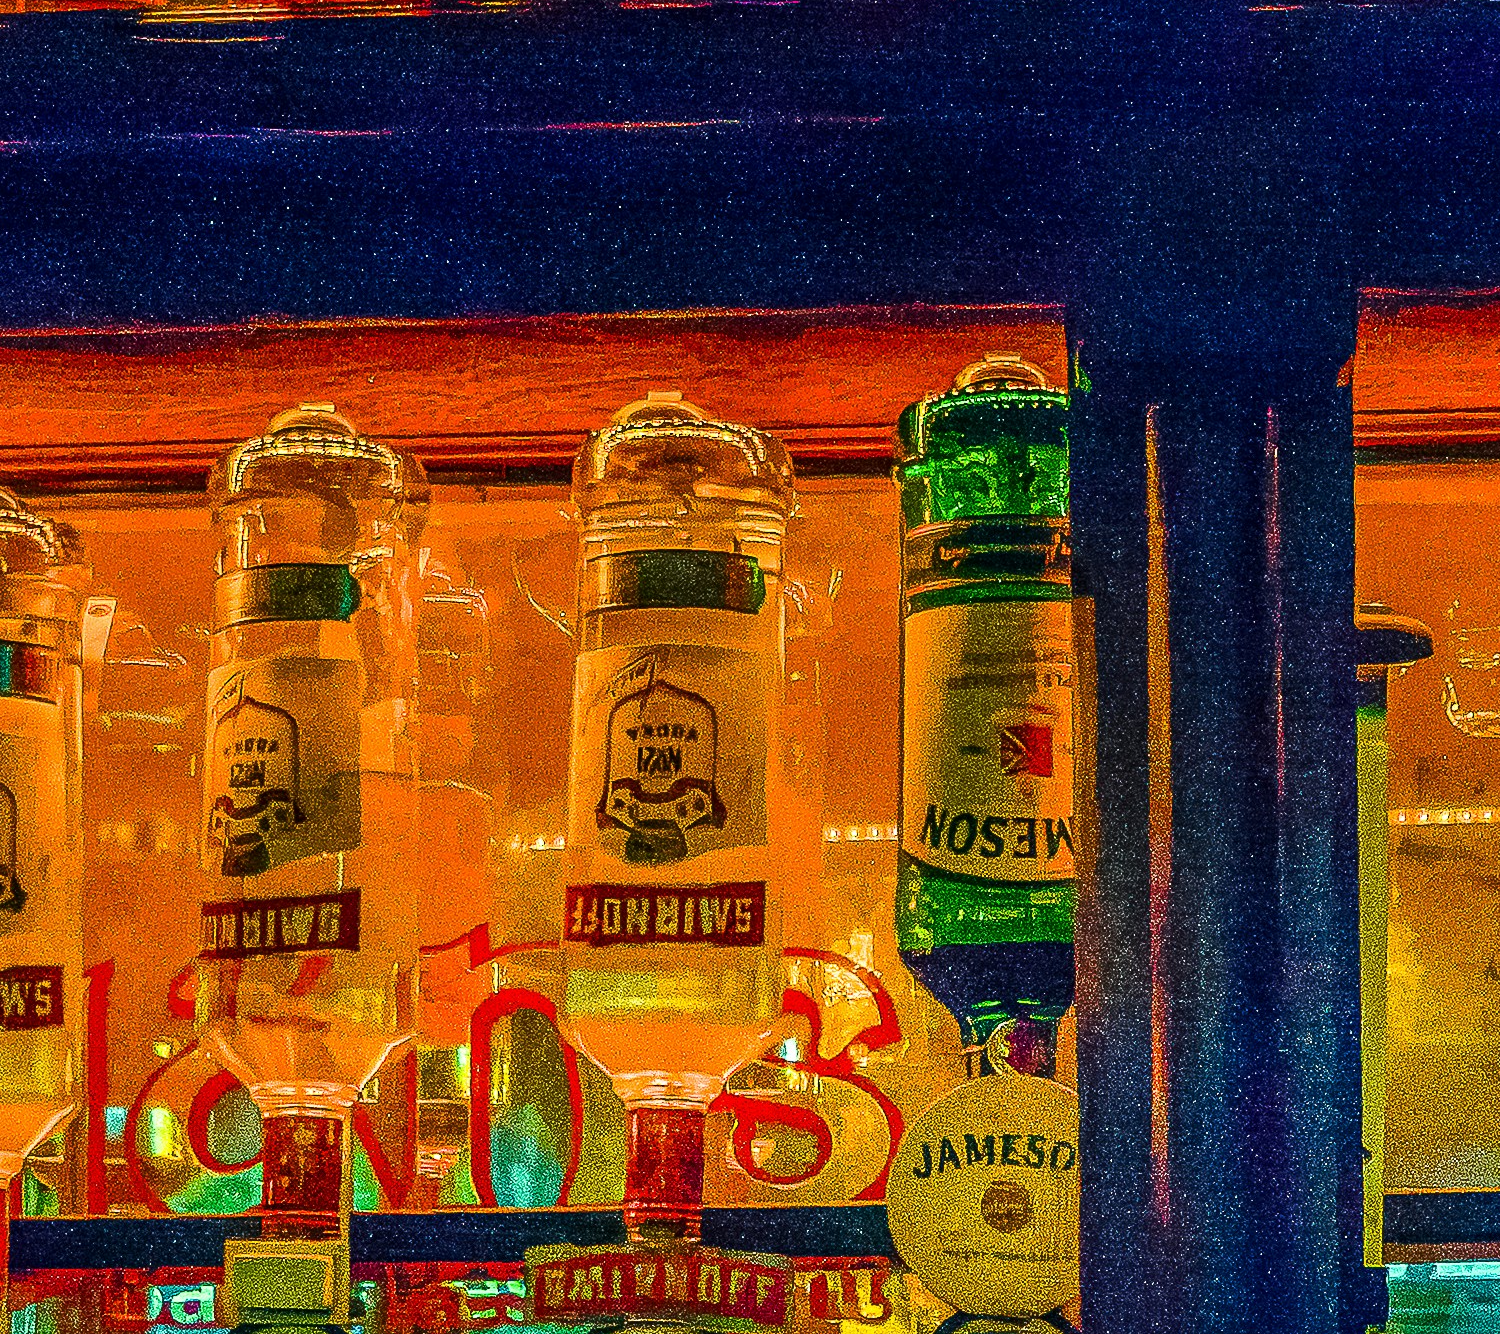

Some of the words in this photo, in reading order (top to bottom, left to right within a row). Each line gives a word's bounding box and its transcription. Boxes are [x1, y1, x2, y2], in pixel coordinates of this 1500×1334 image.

[918, 804, 1076, 859] MESON
[568, 895, 753, 936] SMIRNOFF
[913, 1133, 1077, 1180] JAMESO
[543, 1256, 774, 1316] SMIRNOFF
